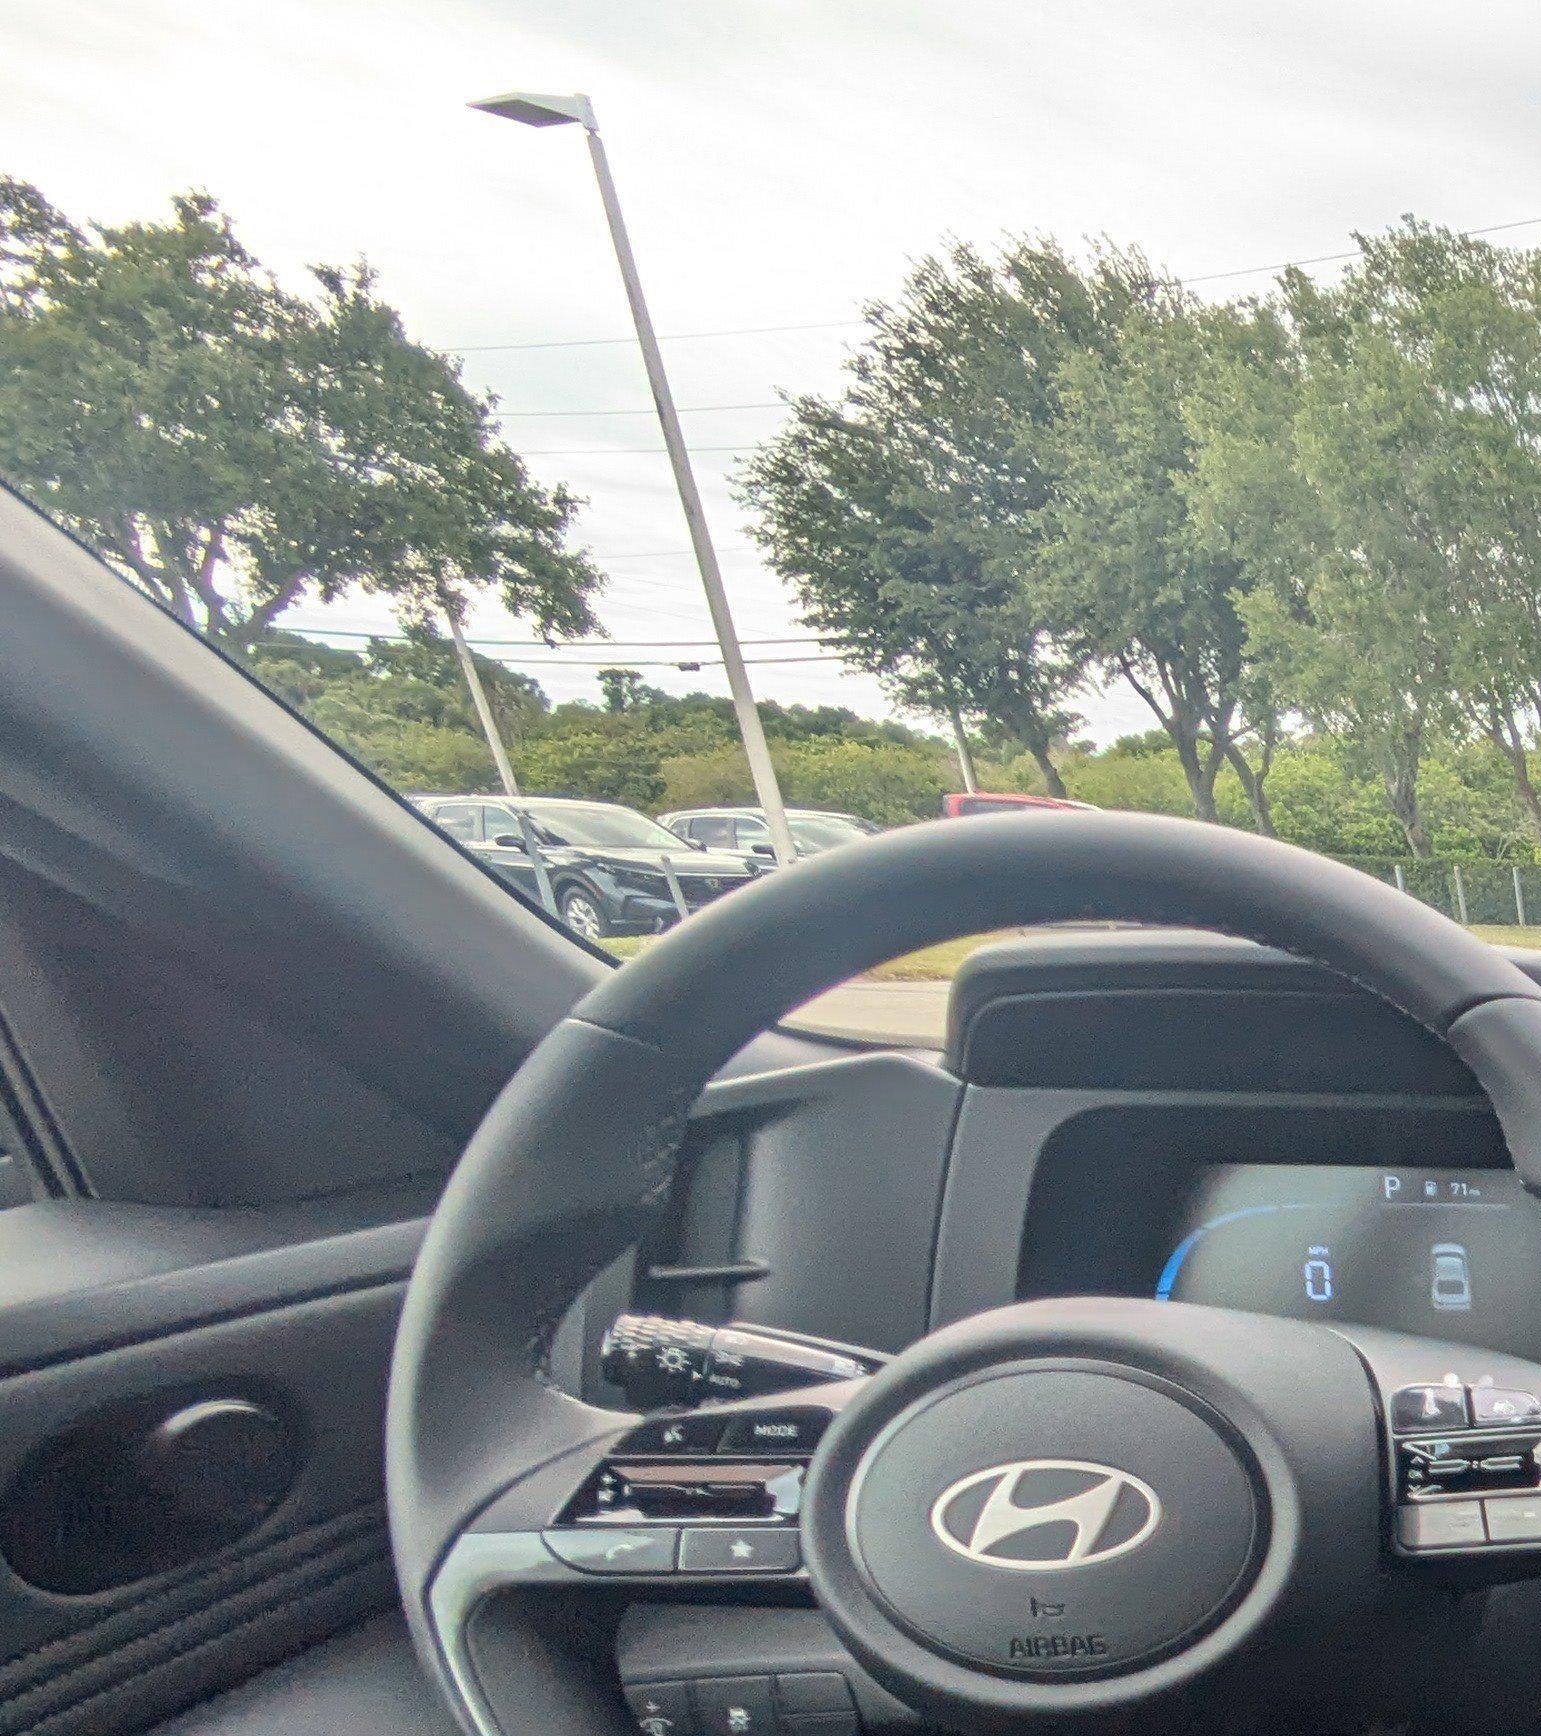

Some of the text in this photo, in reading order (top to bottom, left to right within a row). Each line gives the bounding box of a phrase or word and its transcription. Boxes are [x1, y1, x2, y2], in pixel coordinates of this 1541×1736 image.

[1383, 1176, 1401, 1199] P
[1450, 1182, 1467, 1197] 71
[1304, 1260, 1333, 1301] 0
[753, 1423, 800, 1438] MODE
[1009, 1633, 1108, 1659] AIRBAG
